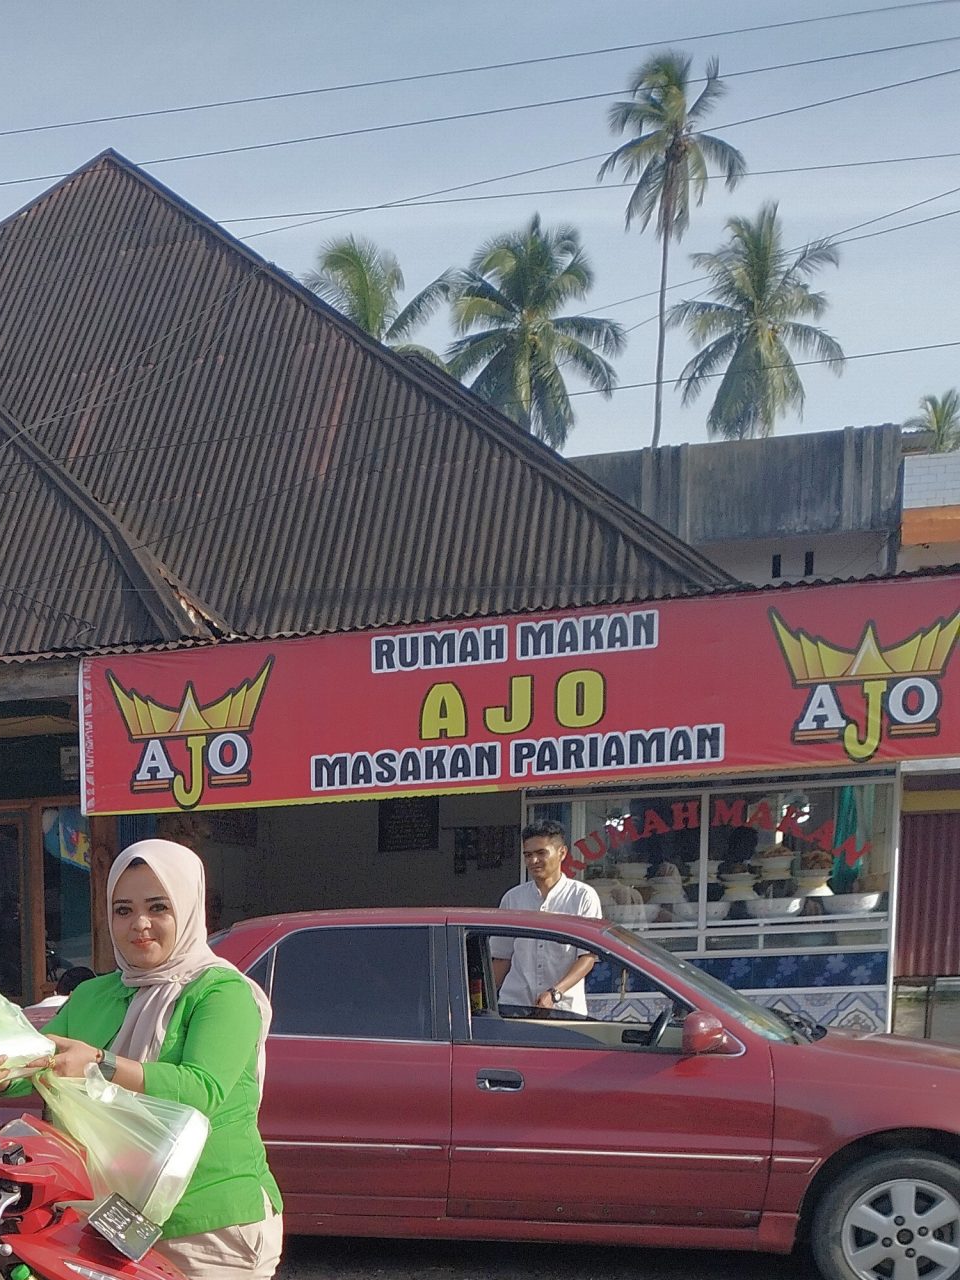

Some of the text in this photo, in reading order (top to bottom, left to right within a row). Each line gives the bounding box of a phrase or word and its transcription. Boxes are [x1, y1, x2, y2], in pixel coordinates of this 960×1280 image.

[373, 611, 657, 672] RUMAH MAKAN
[420, 669, 605, 740] AJO
[798, 677, 939, 759] AJO
[136, 732, 249, 807] AJO
[312, 724, 723, 789] MASAKAN PARIAMAN
[560, 800, 873, 877] RUMAH MAKAN
